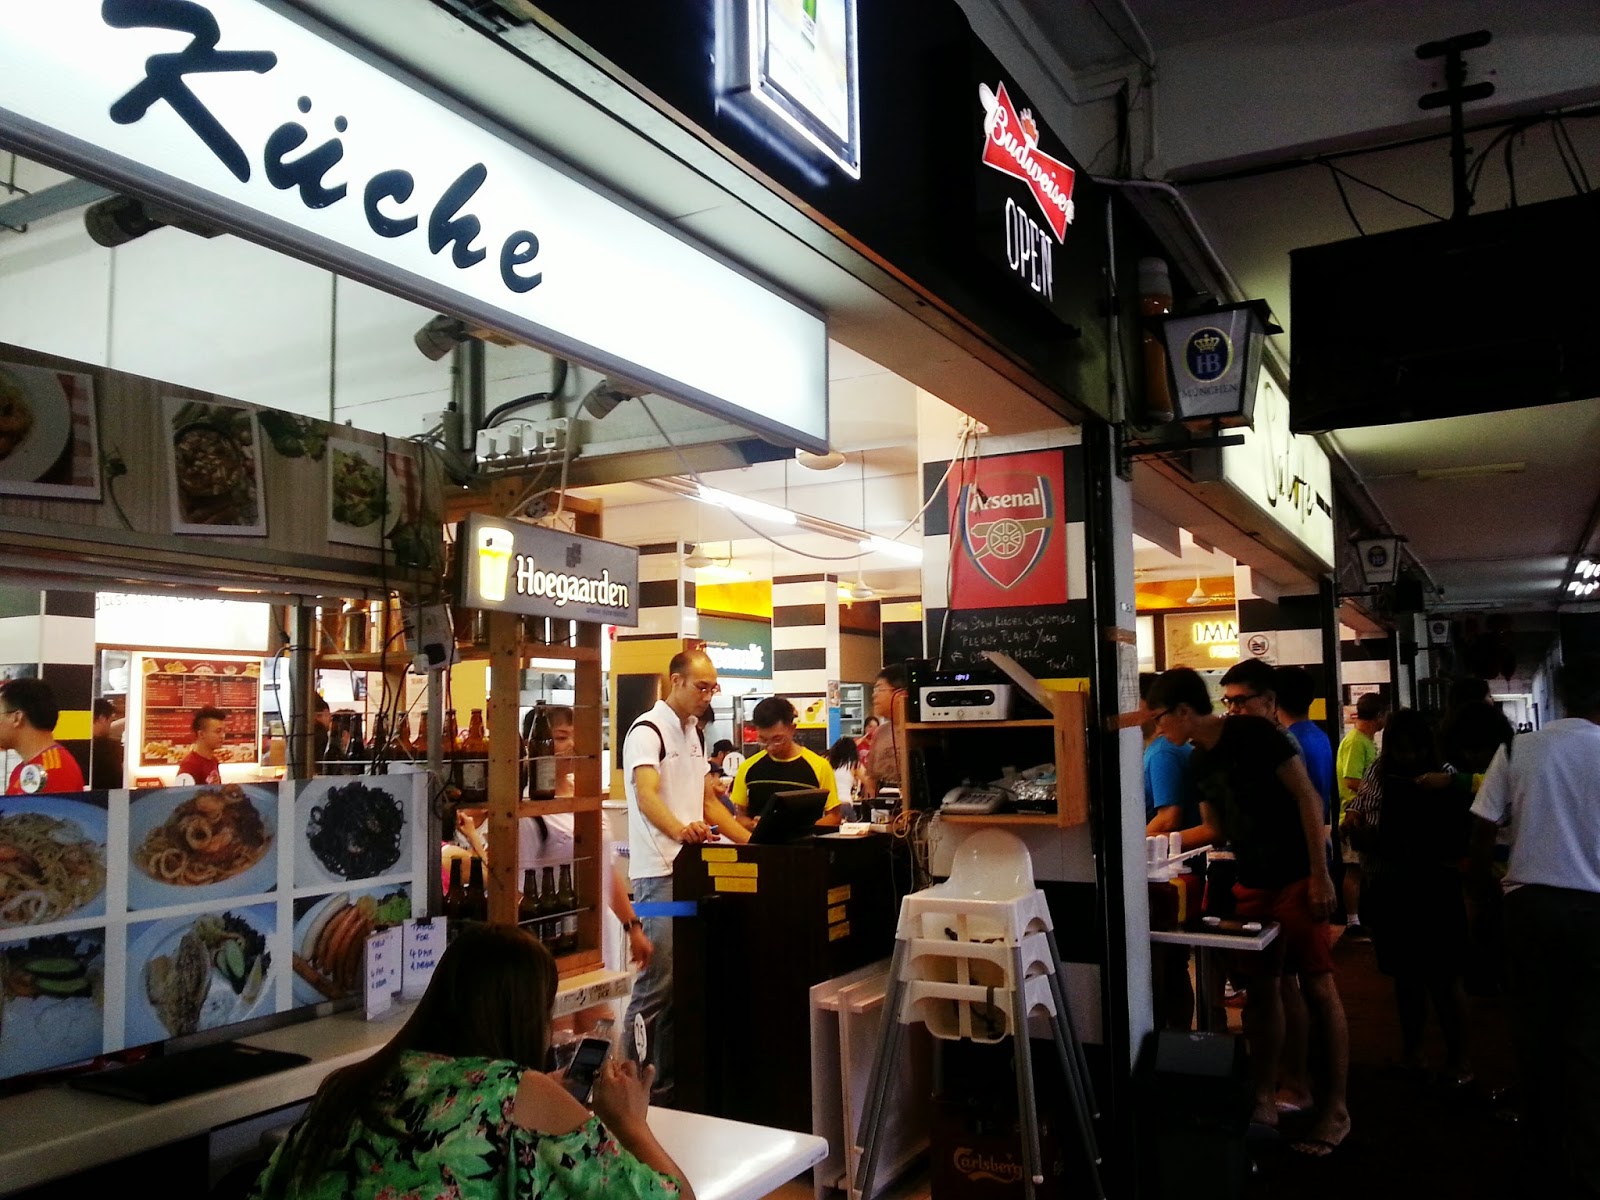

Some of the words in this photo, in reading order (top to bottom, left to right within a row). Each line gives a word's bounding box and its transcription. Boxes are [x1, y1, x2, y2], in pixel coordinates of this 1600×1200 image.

[101, 0, 542, 293] Küche
[991, 105, 1075, 224] Budweiser
[1006, 197, 1053, 302] OPEN
[1196, 352, 1222, 374] HB
[970, 487, 1041, 513] Arsenal
[516, 554, 630, 608] Hoegaarden
[953, 1147, 1024, 1181] Carlsberg
